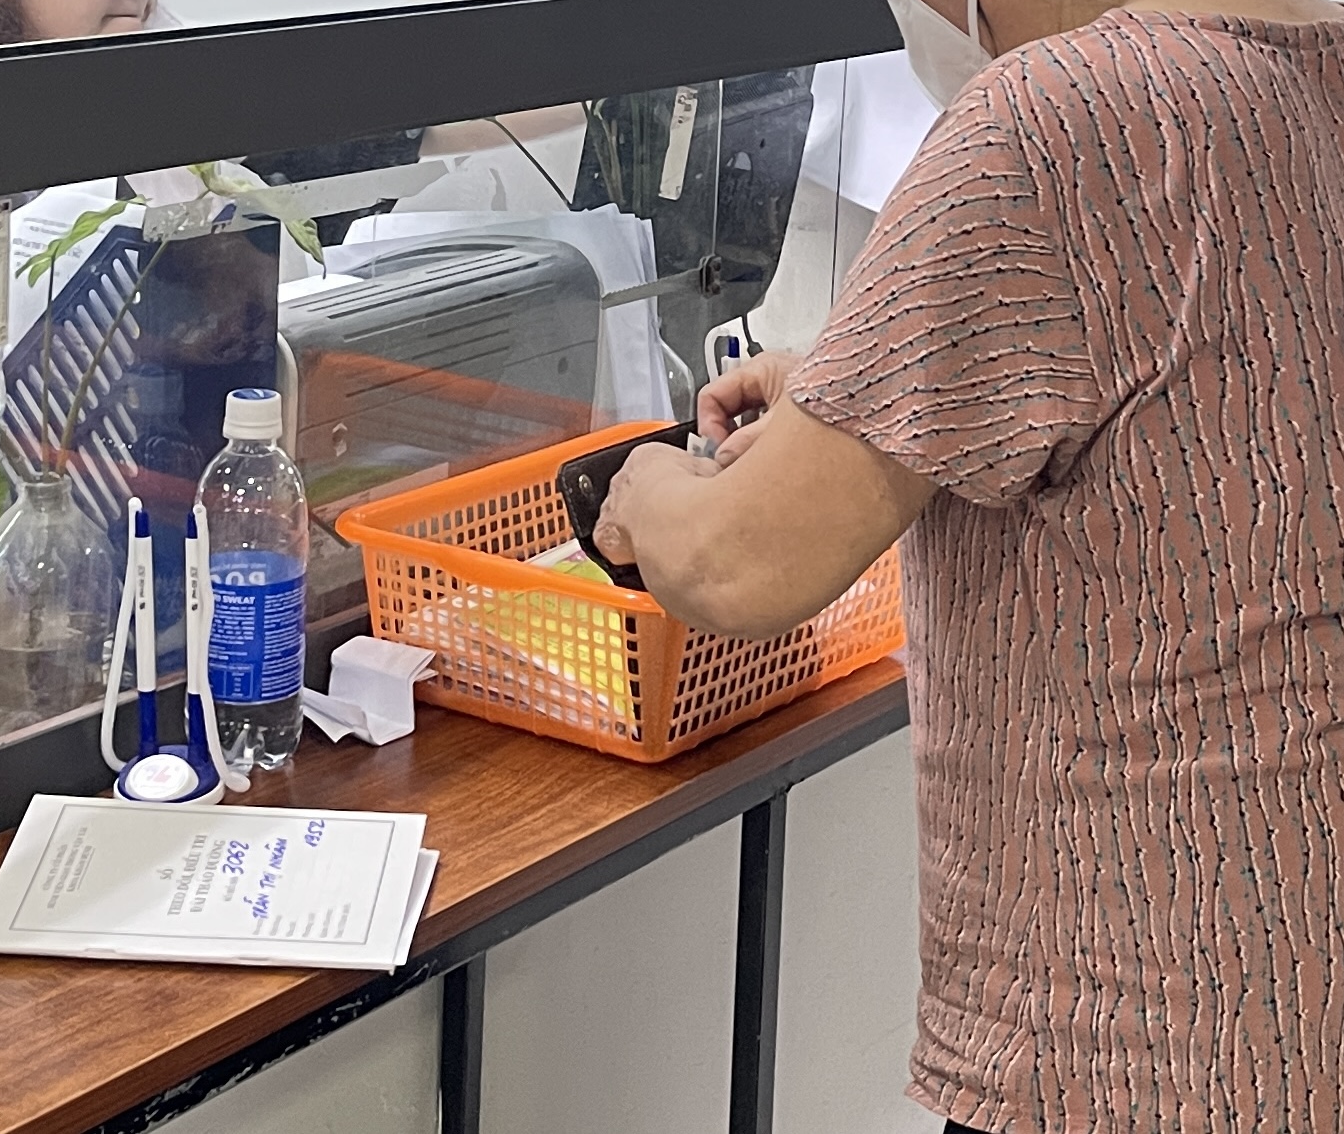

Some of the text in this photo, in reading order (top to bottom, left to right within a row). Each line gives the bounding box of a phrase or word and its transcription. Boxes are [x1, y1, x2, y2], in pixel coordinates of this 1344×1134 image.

[223, 596, 255, 605] SWEAT
[304, 819, 326, 848] 1952
[222, 840, 250, 875] 3062
